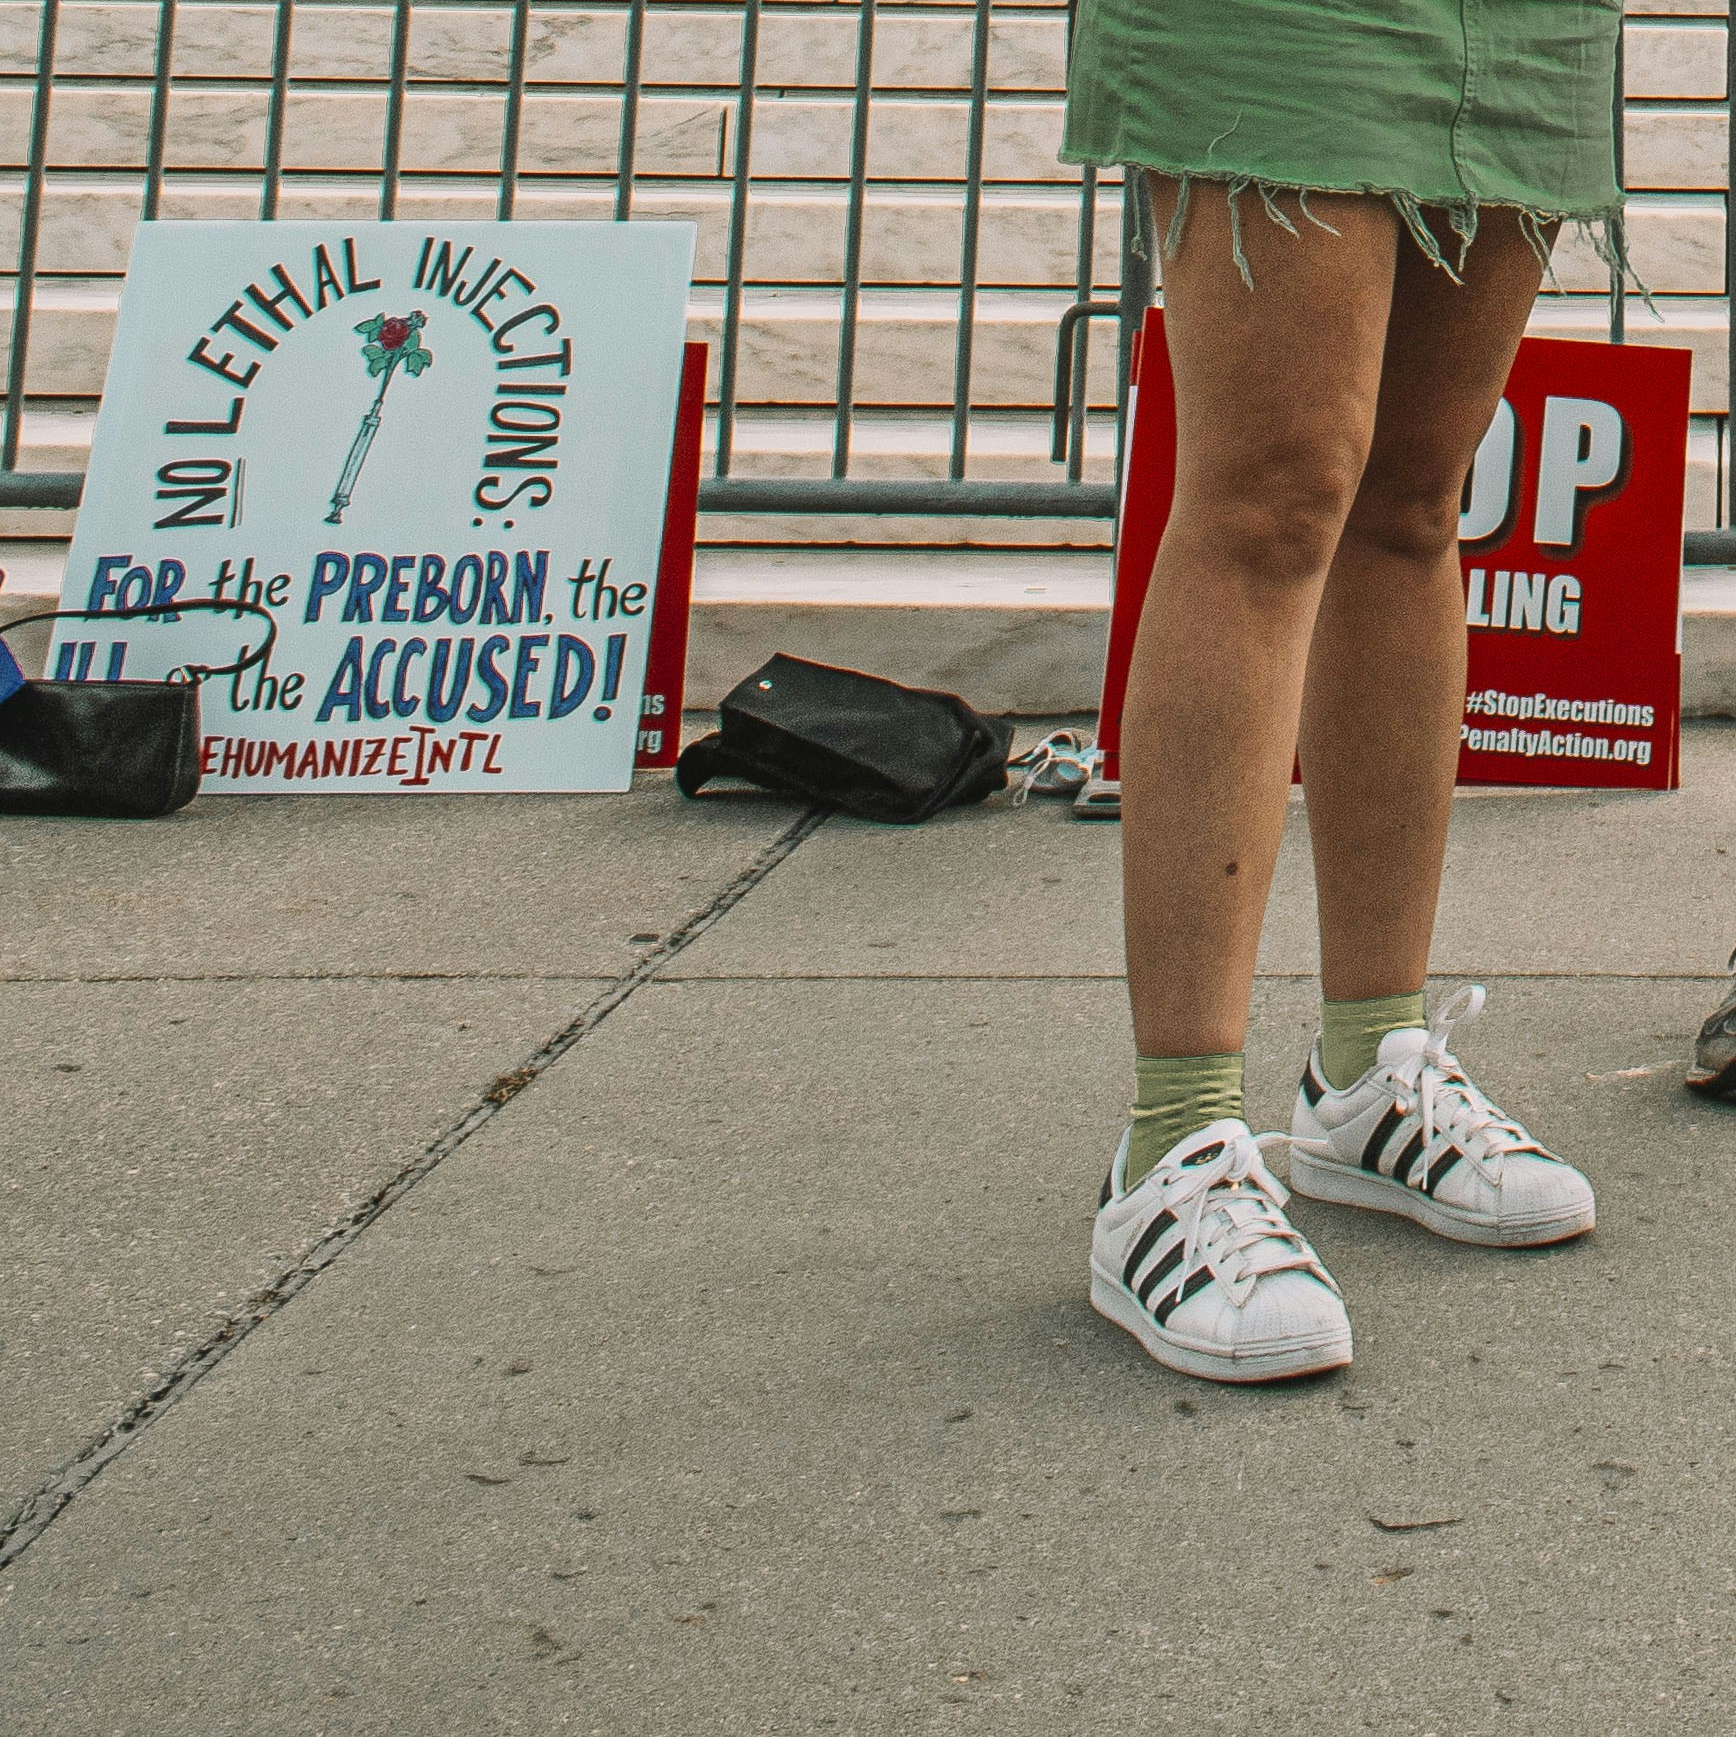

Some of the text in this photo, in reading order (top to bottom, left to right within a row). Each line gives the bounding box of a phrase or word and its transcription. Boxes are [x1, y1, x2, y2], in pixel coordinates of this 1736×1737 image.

[165, 237, 382, 435] LETHAL
[153, 458, 233, 529] NO
[1458, 396, 1624, 546] OP
[86, 550, 649, 625] FOR the PREBORN, the
[1466, 568, 1581, 635] LING
[230, 633, 627, 723] the ACCUSED!
[1466, 689, 1655, 727] #StopExecutions
[202, 726, 502, 786] EHUMANIZEINTL
